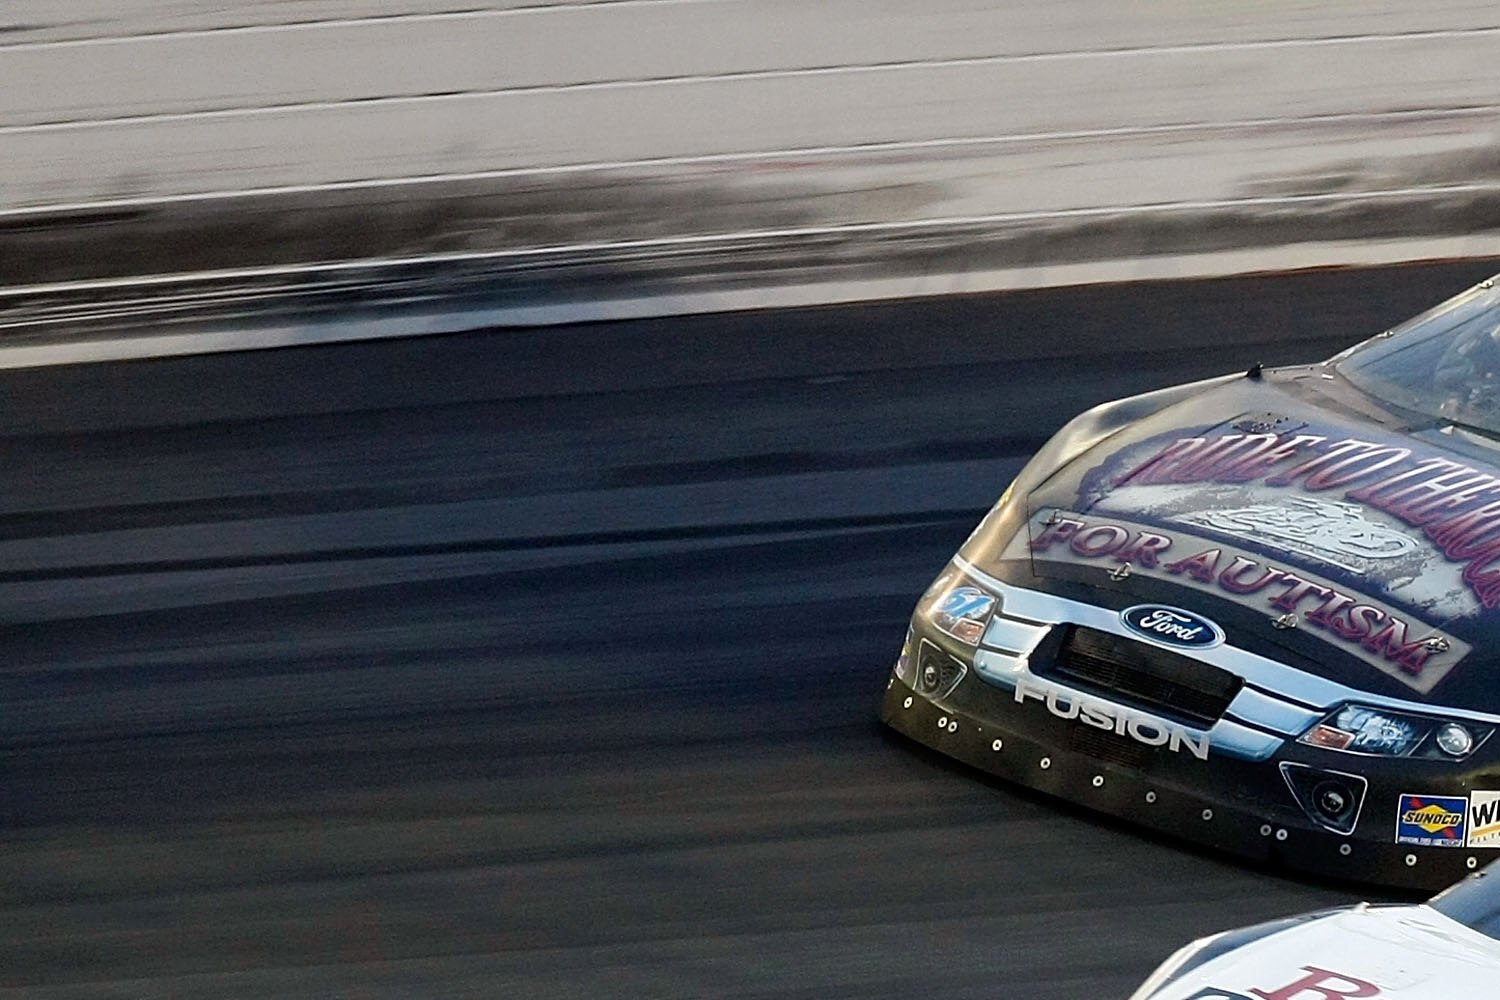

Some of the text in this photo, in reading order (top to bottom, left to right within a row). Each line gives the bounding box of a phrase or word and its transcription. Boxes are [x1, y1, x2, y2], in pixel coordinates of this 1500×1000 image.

[1110, 433, 1327, 485] RIDE
[1264, 440, 1411, 491] TO
[1029, 519, 1442, 676] FOR AUTISM
[1140, 609, 1204, 641] Ford
[1014, 678, 1211, 761] FUSION
[1404, 811, 1461, 826] SUNOCO
